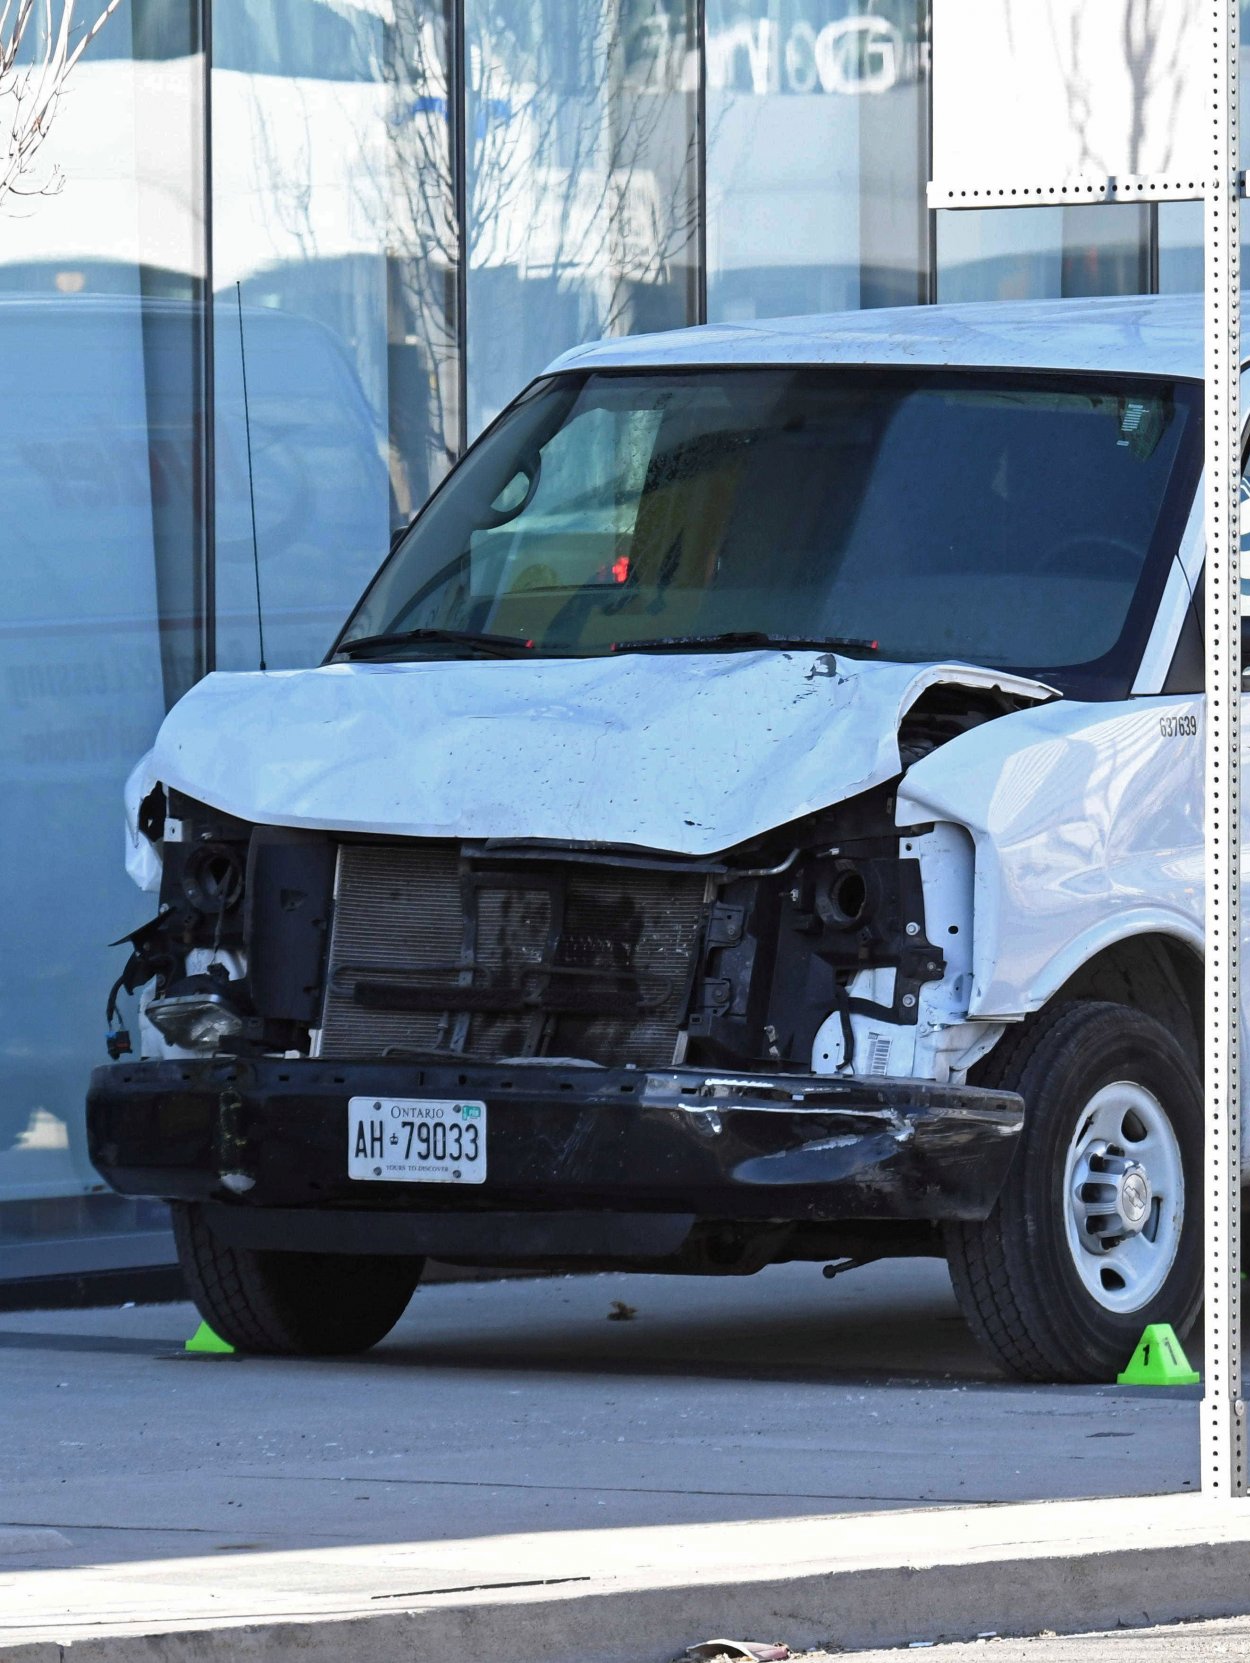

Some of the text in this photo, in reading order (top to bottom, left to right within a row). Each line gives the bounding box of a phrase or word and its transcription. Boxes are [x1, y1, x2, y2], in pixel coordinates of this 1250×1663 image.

[1160, 715, 1197, 737] 637639
[354, 1120, 479, 1162] AH 79033
[1142, 1344, 1150, 1366] 1
